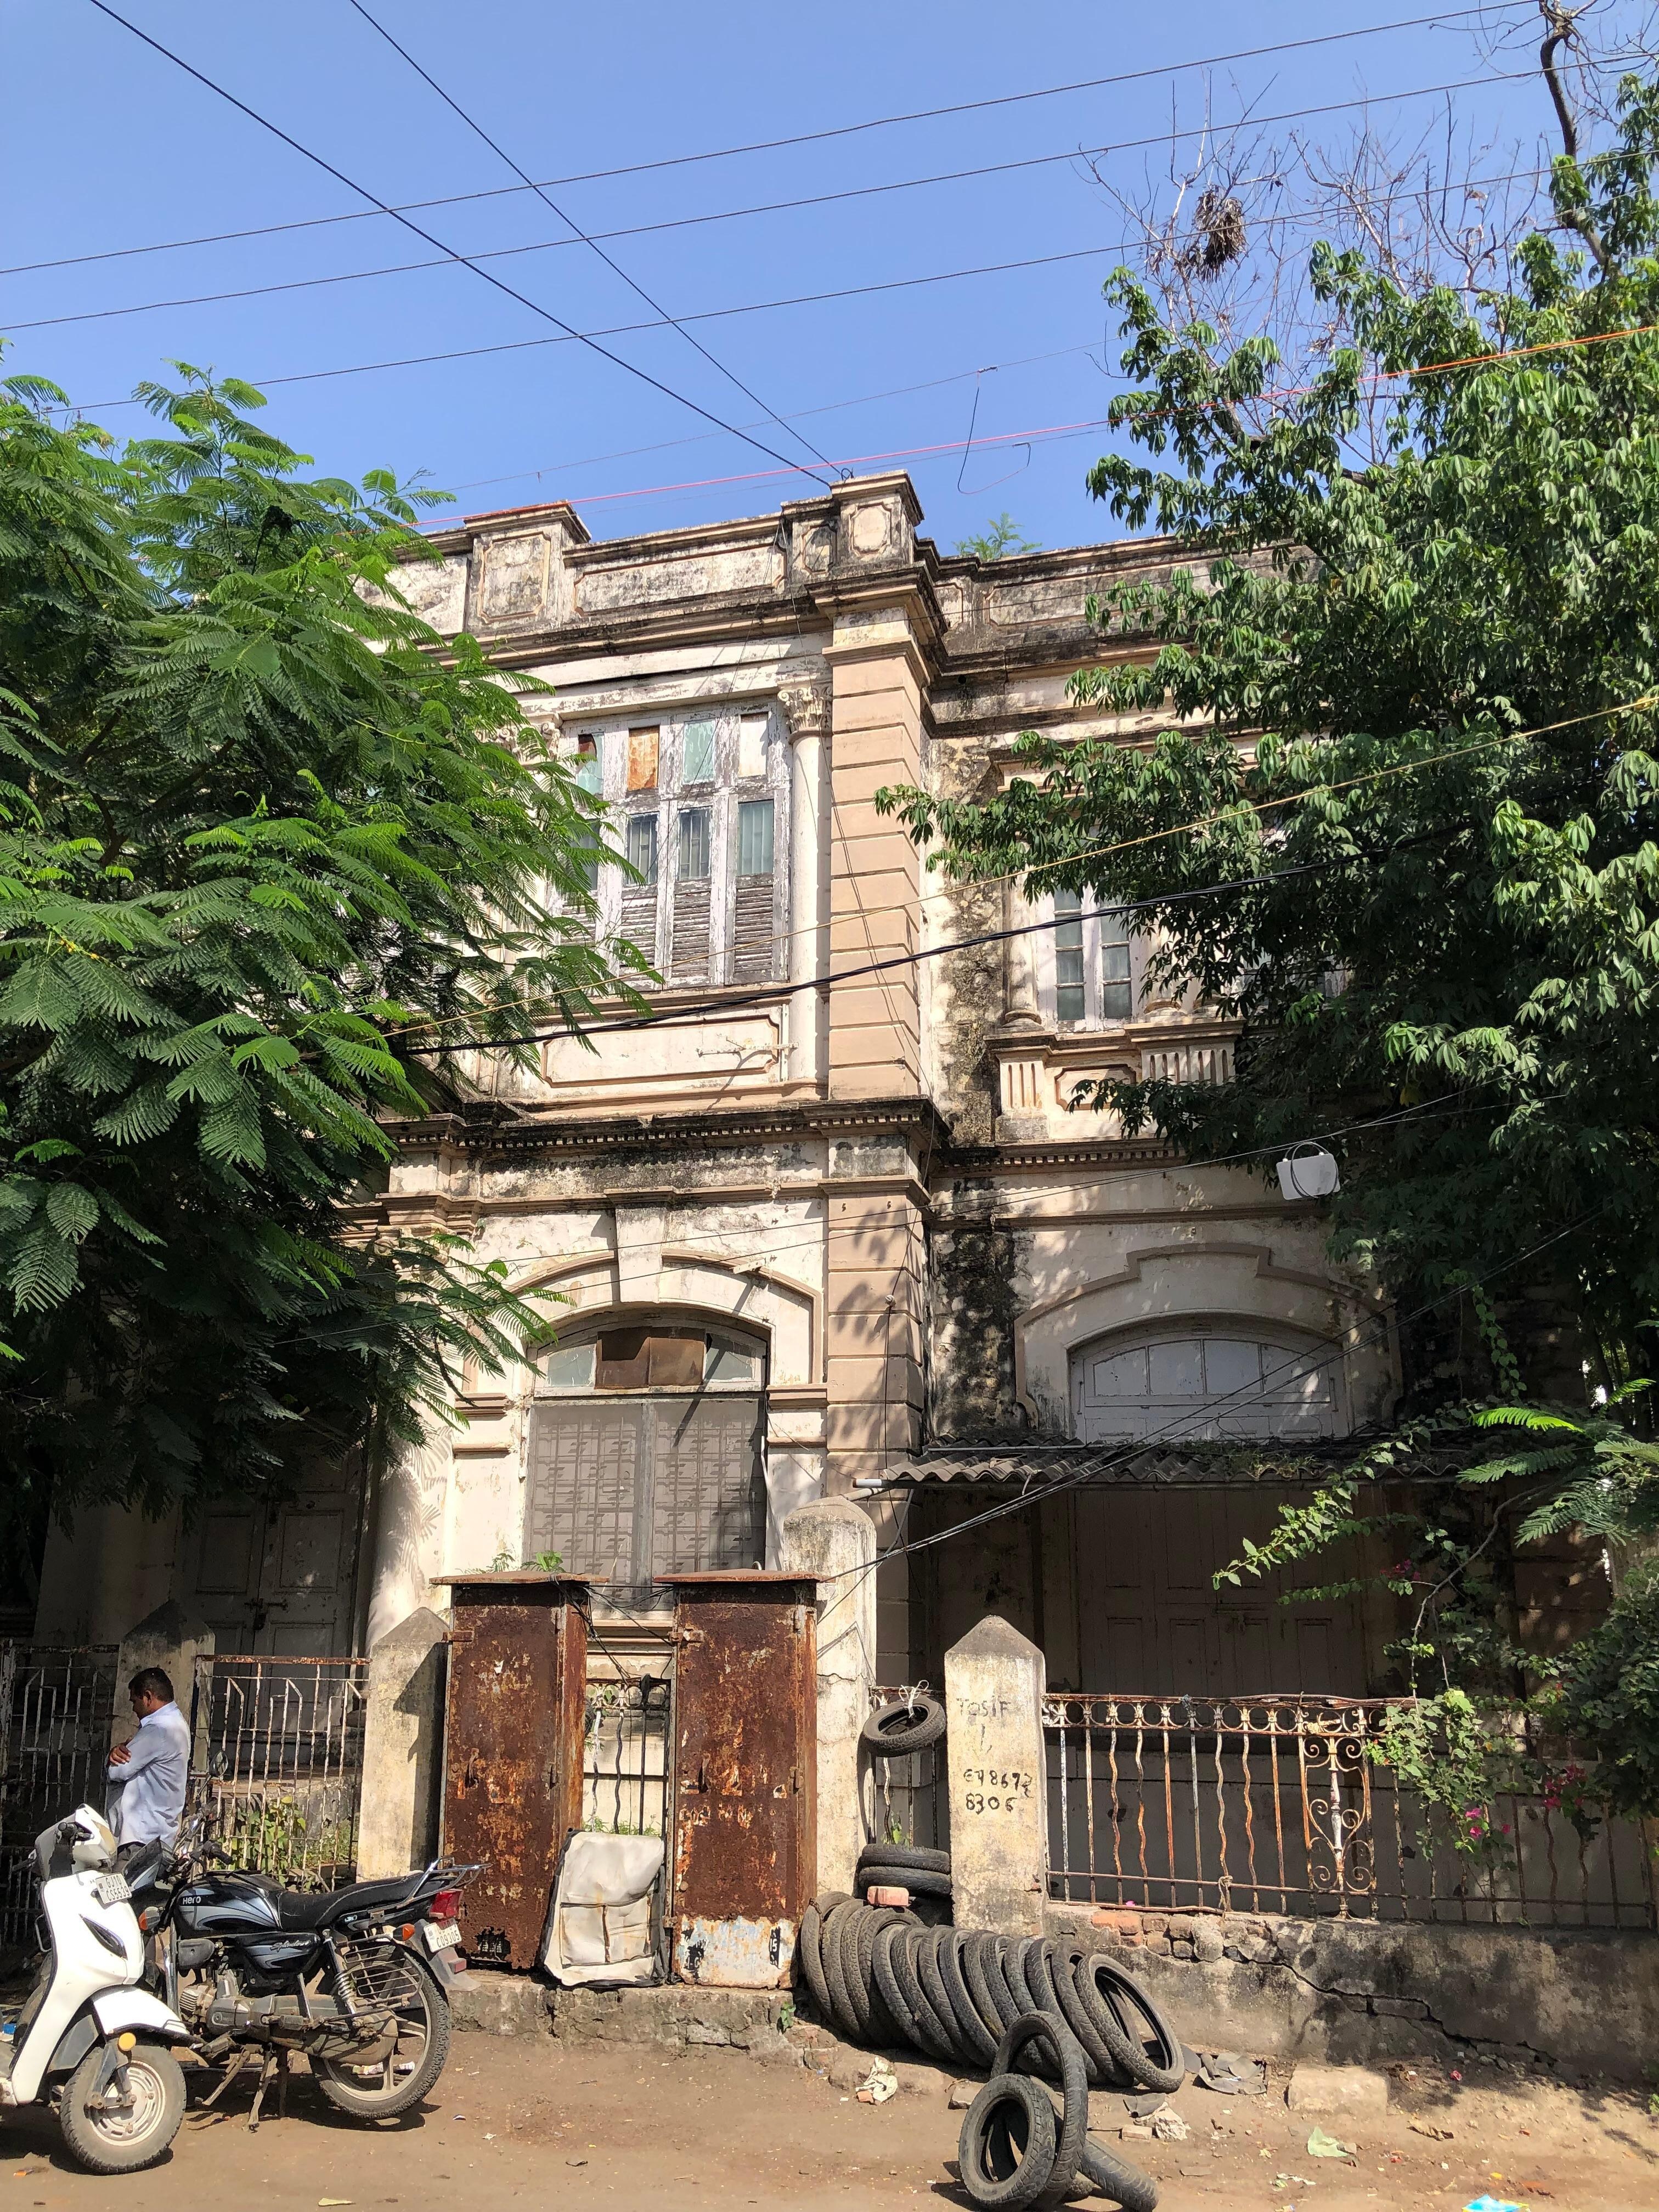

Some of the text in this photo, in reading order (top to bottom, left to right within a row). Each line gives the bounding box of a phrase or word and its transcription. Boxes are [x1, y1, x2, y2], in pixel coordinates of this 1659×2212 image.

[105, 1875, 122, 1888] GJ10
[106, 1886, 130, 1901] CS5539
[182, 1896, 201, 1905] Hero
